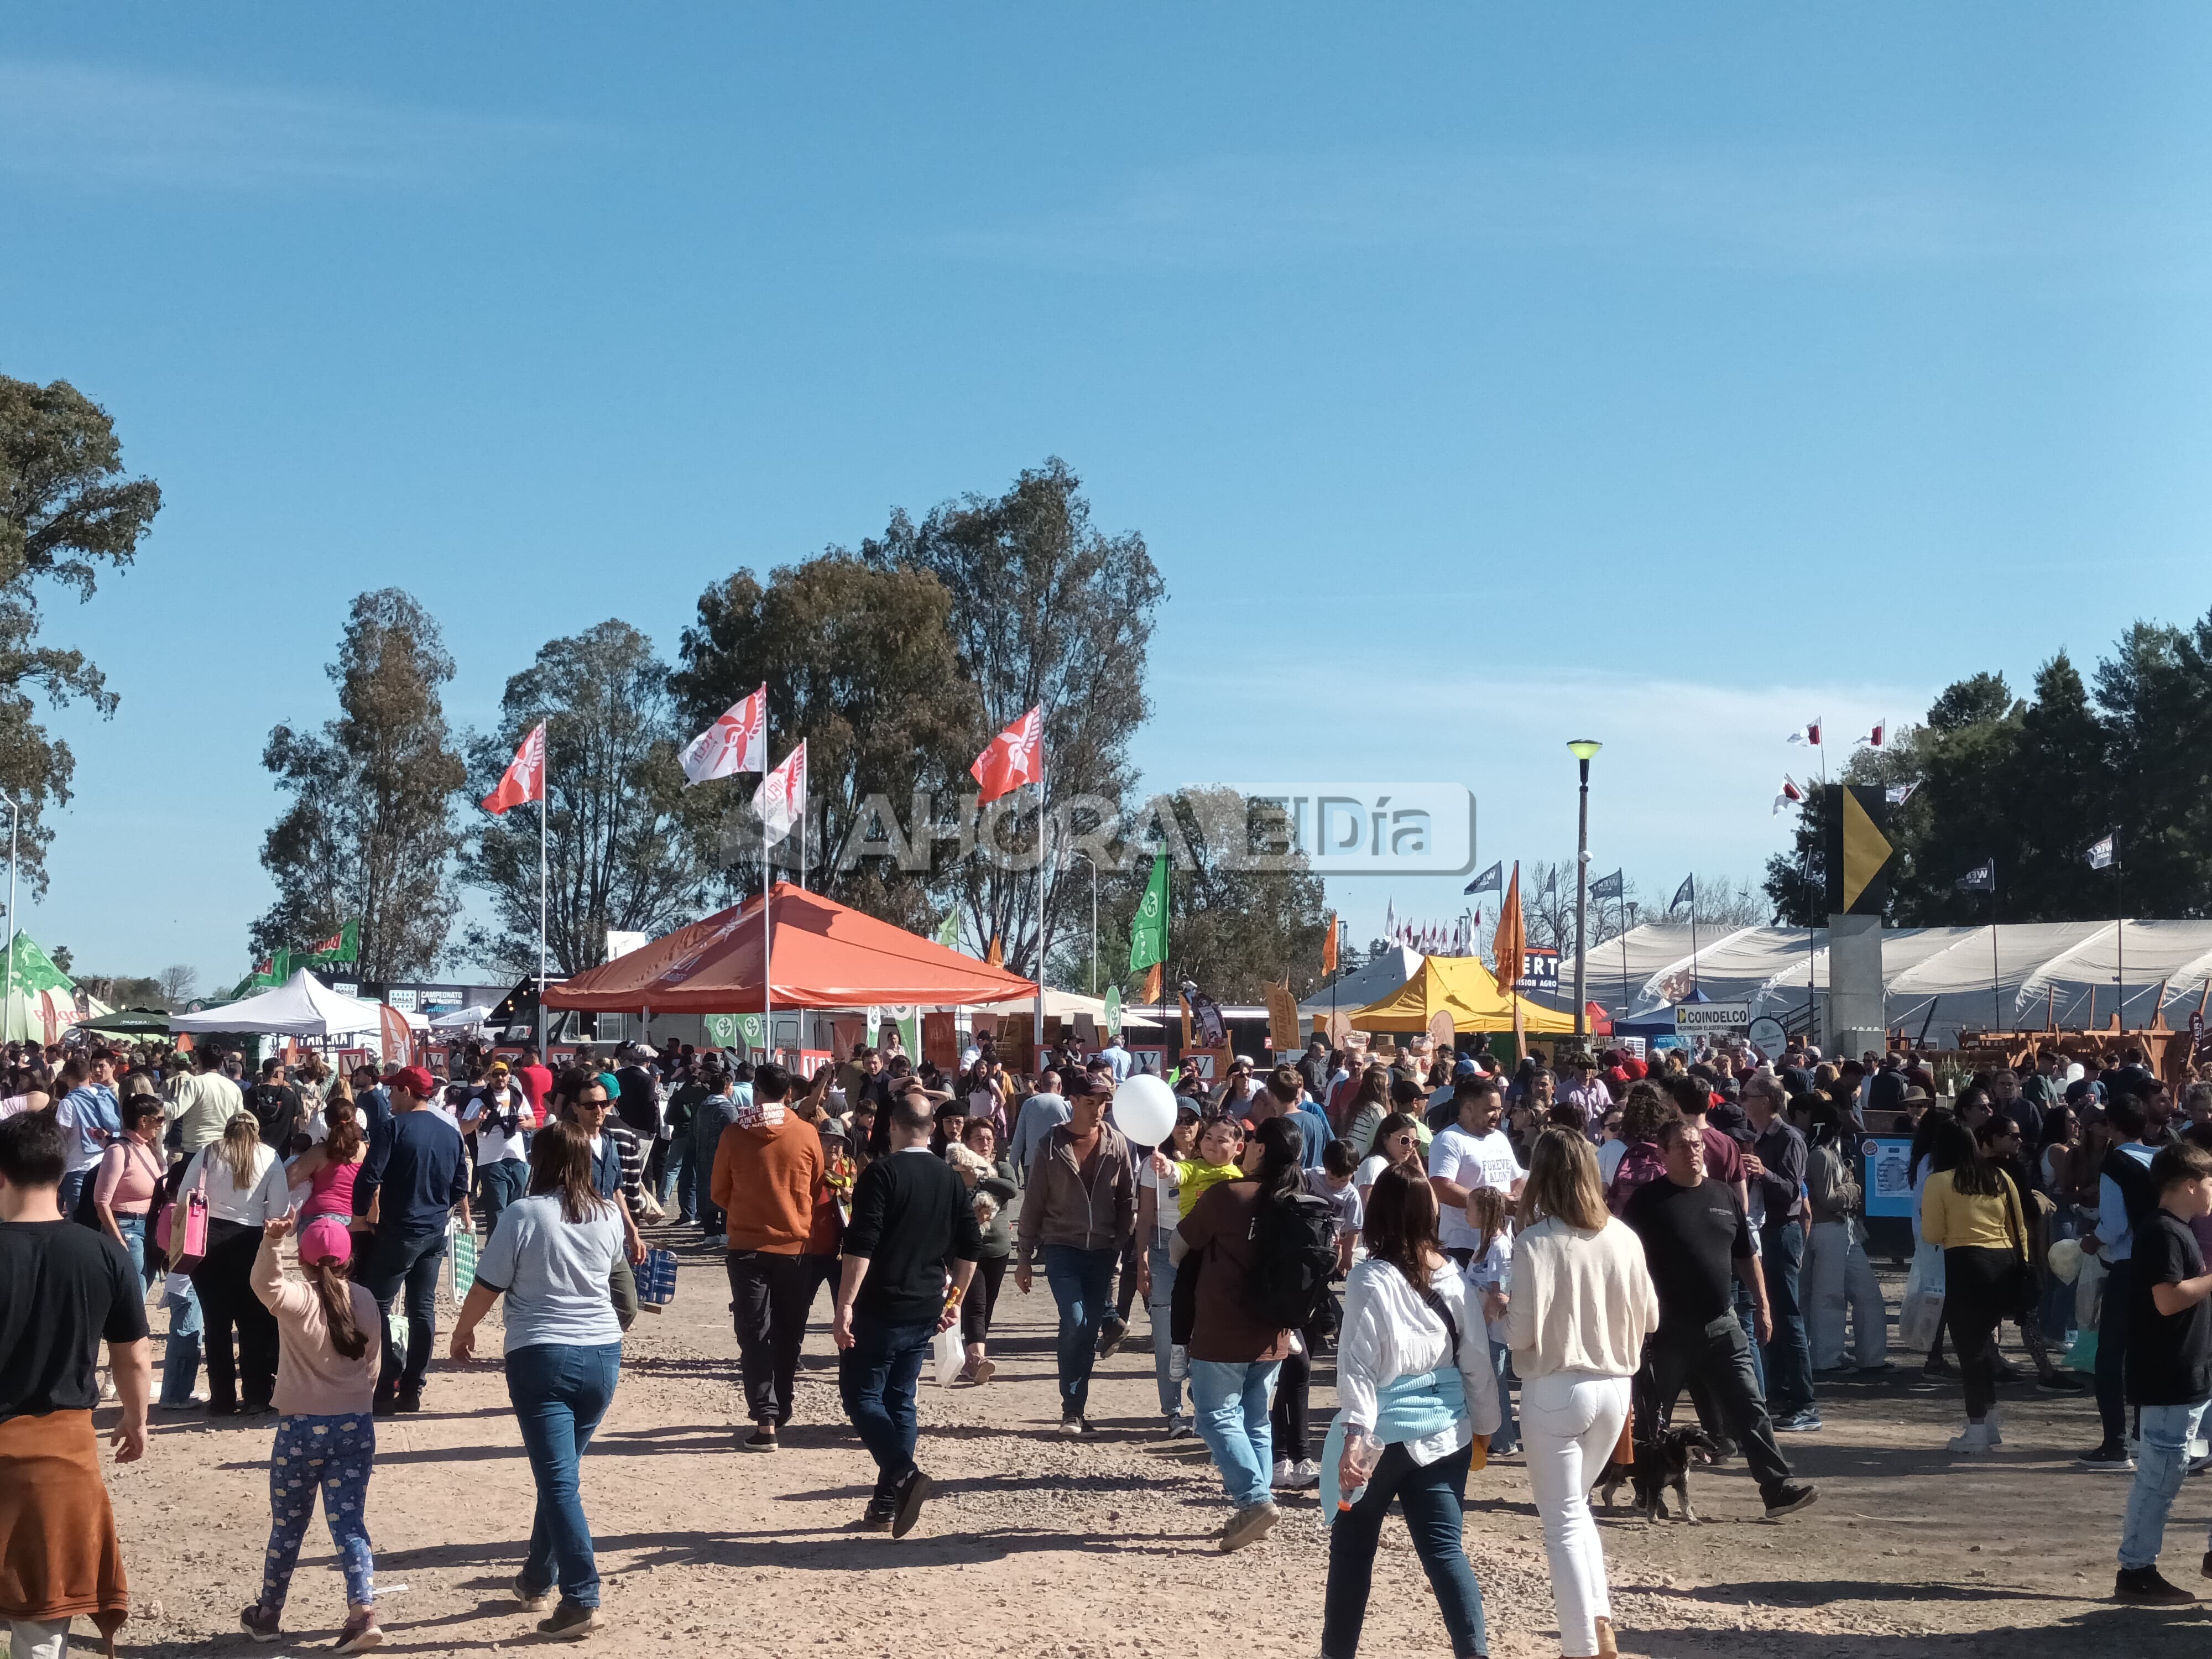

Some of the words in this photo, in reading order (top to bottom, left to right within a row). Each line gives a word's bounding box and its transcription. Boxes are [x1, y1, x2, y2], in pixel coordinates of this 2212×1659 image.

[1523, 957, 1558, 975] ERT
[1688, 1010, 1747, 1024] COINDELCO
[344, 1056, 359, 1073] V
[788, 1056, 799, 1073] V
[1482, 1159, 1512, 1171] FOREVE
